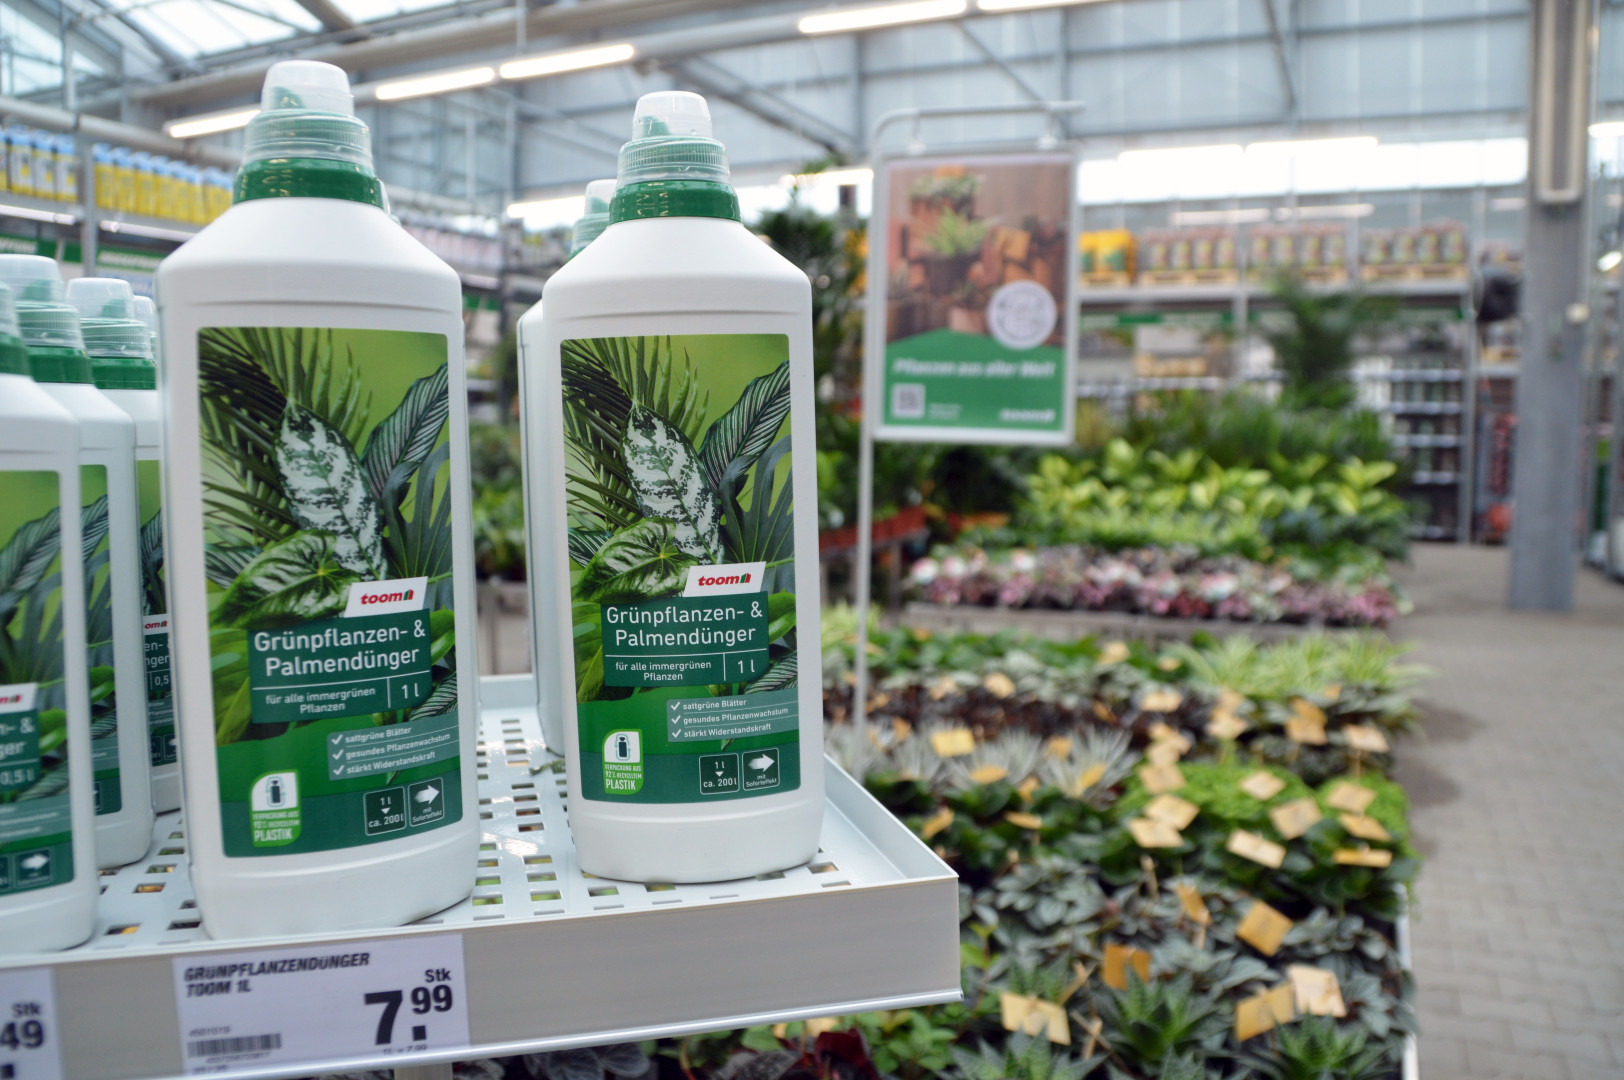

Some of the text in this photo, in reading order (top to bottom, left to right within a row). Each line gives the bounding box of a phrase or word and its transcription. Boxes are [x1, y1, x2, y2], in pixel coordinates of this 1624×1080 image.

[698, 576, 739, 586] toom
[360, 593, 404, 605] toom
[607, 601, 763, 626] Grünpflanzen- &
[254, 620, 426, 653] Grünpflanzen- &
[615, 627, 756, 647] Palmendünger
[266, 647, 420, 676] Palmendünger
[615, 660, 711, 672] für alle immergrünen
[643, 672, 683, 682] Pflanzen
[265, 687, 376, 705] für alle immergrünen
[300, 702, 346, 714] Pflanzen
[682, 699, 747, 712] sattgrüne Blätter
[683, 707, 789, 725] gesundes Pflanzenwachstum
[345, 727, 412, 744] sattgrüne Blätter
[684, 723, 772, 738] stärkt Widerstandskraft
[346, 733, 451, 760] gesundes Pflanzenwachstum
[347, 751, 436, 774] stärkt Widerstandskraft
[605, 778, 636, 790] PLASTIK
[368, 819, 382, 828] ca.
[254, 829, 293, 842] PLASTIK
[425, 968, 452, 983] Stk
[186, 980, 231, 998] TOOM
